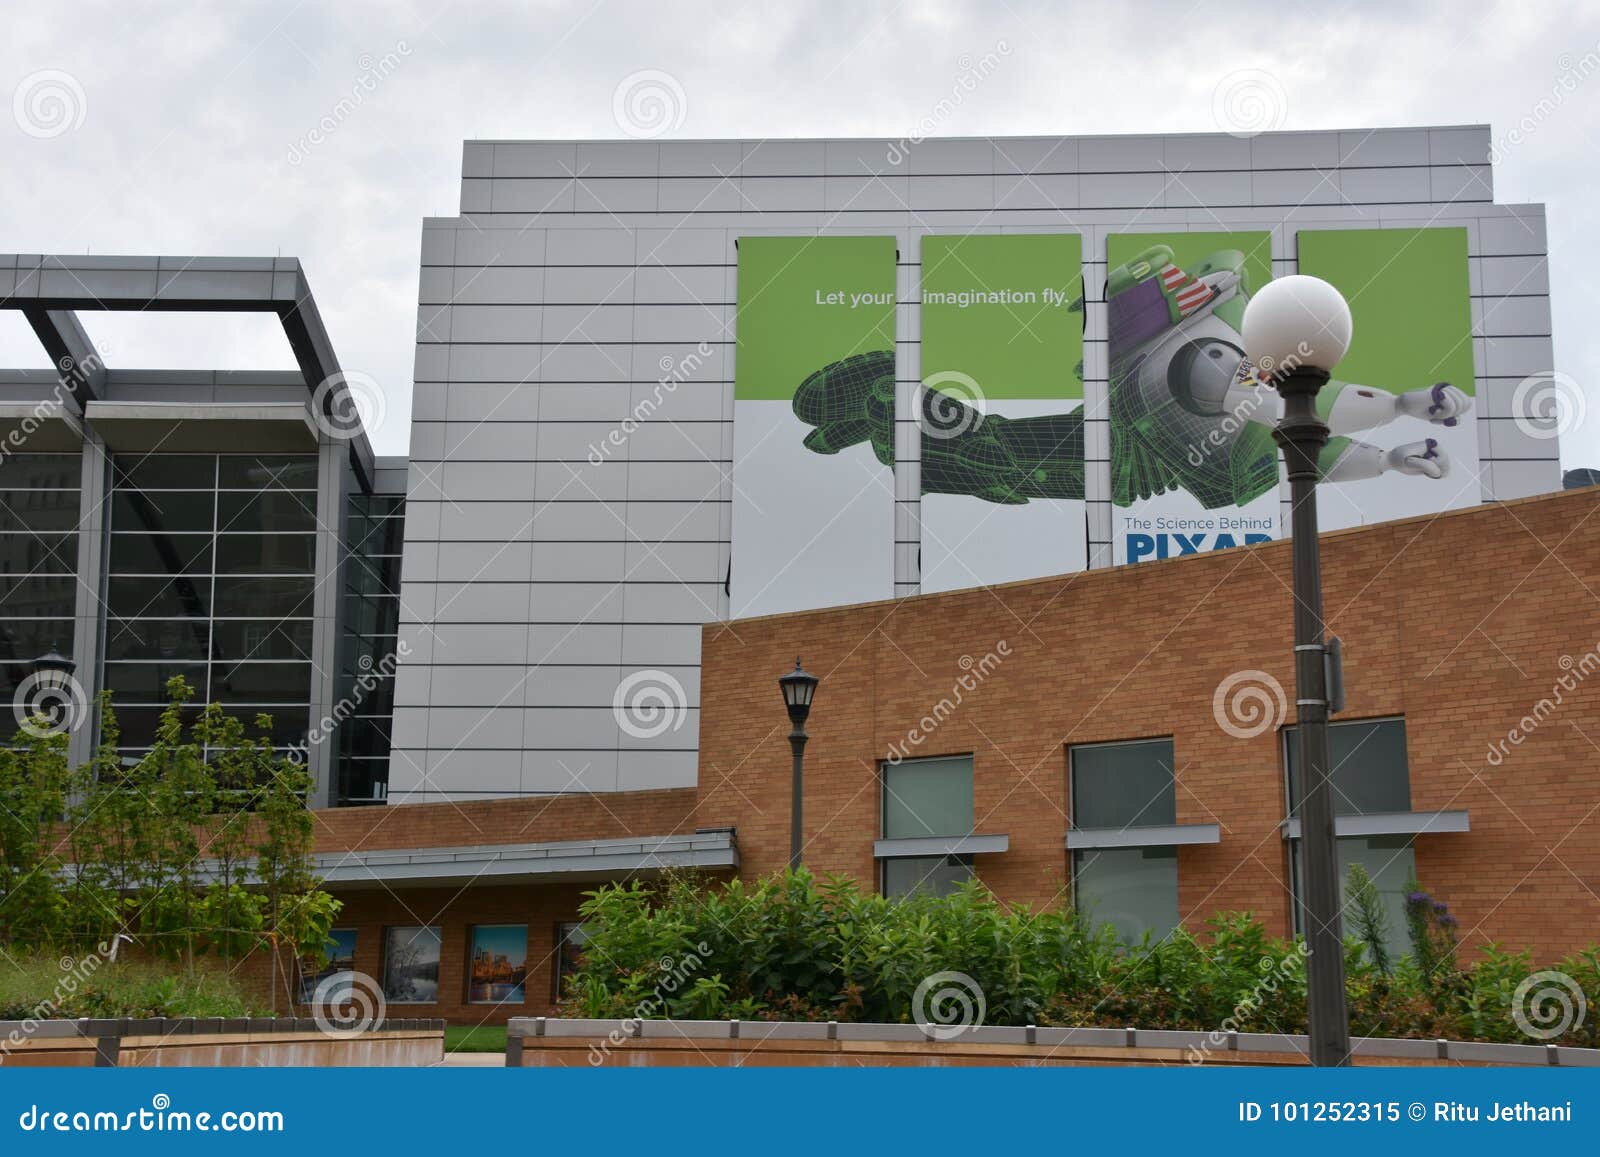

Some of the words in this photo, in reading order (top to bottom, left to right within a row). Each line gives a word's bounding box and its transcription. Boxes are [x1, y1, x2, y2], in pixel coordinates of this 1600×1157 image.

[815, 290, 845, 305] Let
[850, 291, 894, 309] your
[922, 289, 1036, 308] imagination
[1042, 288, 1069, 307] fly.
[1123, 517, 1151, 530] The
[1156, 517, 1215, 530] Science
[1219, 517, 1273, 530] Behind
[1126, 533, 1273, 565] PIXA
